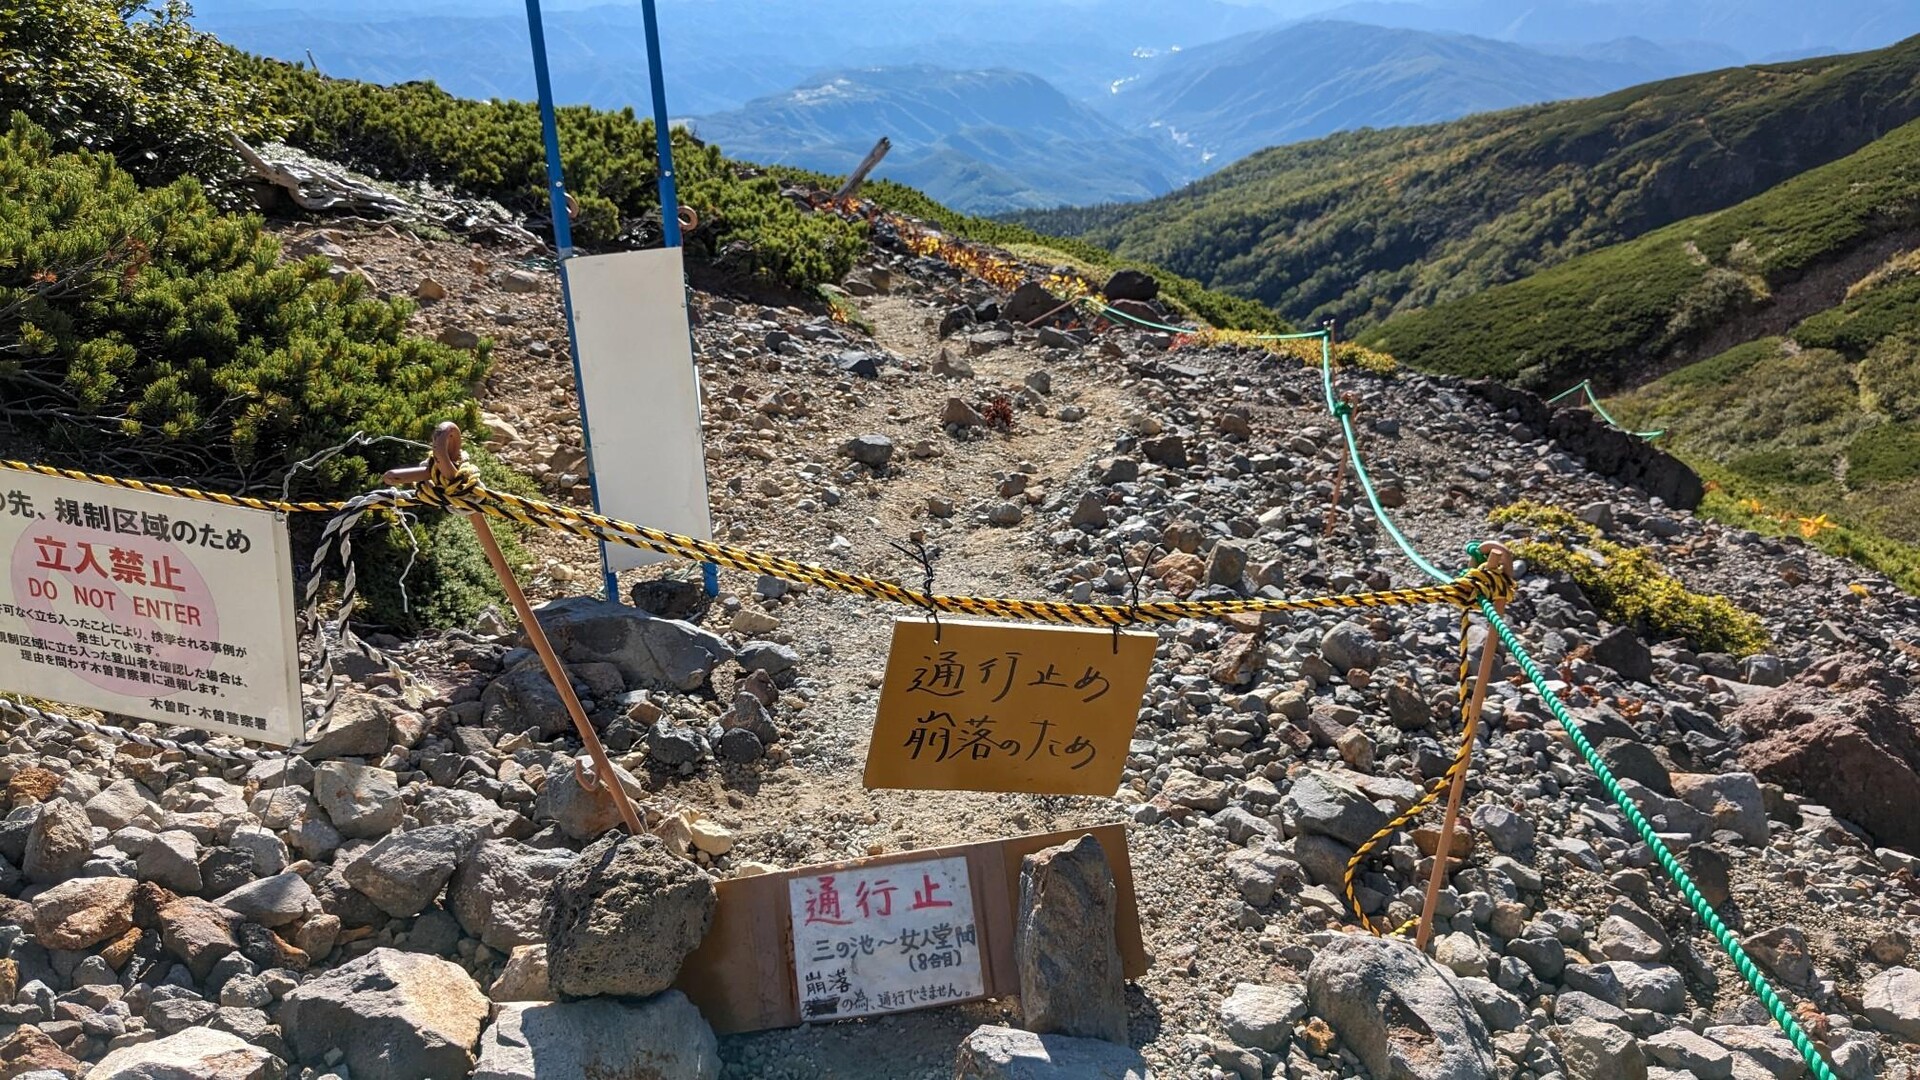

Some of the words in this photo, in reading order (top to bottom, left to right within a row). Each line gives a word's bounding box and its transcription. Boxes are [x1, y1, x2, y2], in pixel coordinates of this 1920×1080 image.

[0, 489, 251, 554] 先、規制区域のため
[33, 535, 186, 592] 立入禁止
[28, 577, 58, 600] DO
[73, 585, 117, 612] NOT
[132, 596, 202, 627] ENTER
[0, 603, 248, 659] 可なく立ち入ったことにより、検挙される事例が
[76, 631, 161, 657] 発生しています。
[20, 649, 226, 698] 理由を問わず木曽警察署に通報します。
[906, 651, 1110, 703] 通行止め
[149, 697, 268, 731] 木曽町・木曽警察署
[903, 710, 1096, 770] 崩落のため
[804, 874, 953, 926] 通行止
[805, 967, 852, 997] 崩落
